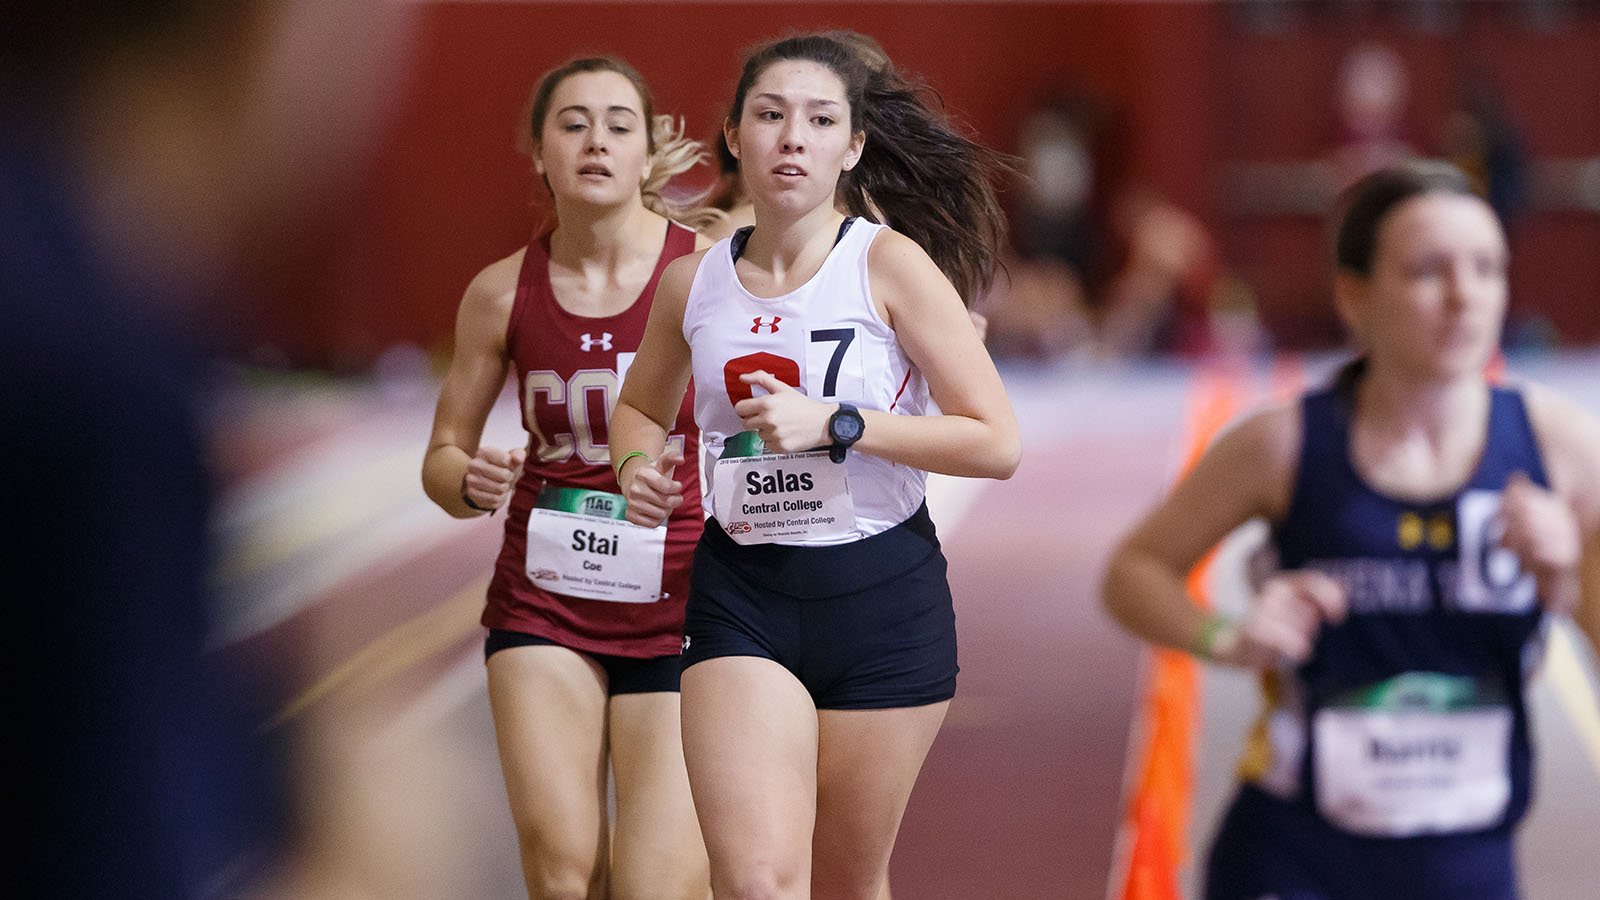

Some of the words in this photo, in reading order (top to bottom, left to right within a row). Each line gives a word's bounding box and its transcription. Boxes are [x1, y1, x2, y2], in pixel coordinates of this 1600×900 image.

[810, 327, 856, 398] 7
[525, 368, 686, 474] CO
[746, 469, 814, 496] Salas
[742, 502, 780, 515] Central
[784, 499, 823, 512] College
[754, 521, 776, 529] Hosted
[777, 520, 786, 528] by
[787, 518, 810, 527] Central
[811, 516, 835, 524] College
[572, 529, 618, 556] Stai
[583, 560, 602, 572] Coe
